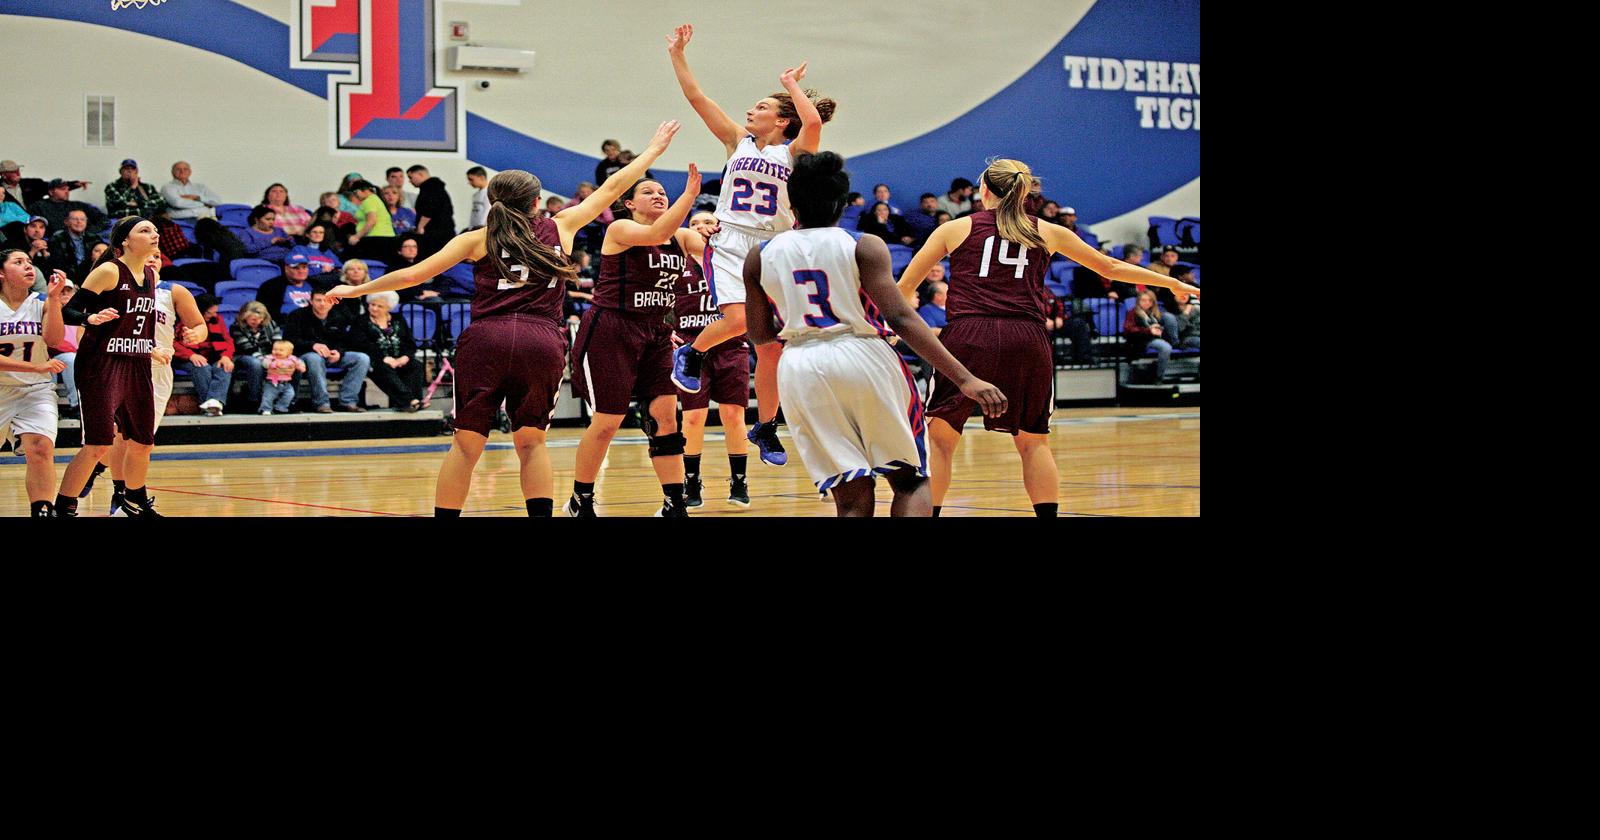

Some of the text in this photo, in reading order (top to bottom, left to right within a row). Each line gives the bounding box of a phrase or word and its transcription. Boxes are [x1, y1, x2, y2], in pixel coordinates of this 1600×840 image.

[731, 178, 778, 216] 23
[648, 253, 687, 272] LADY
[979, 235, 1029, 279] 14
[687, 279, 709, 294] LA
[793, 269, 841, 328] 3
[0, 321, 43, 336] ERETTE
[132, 315, 146, 335] 3
